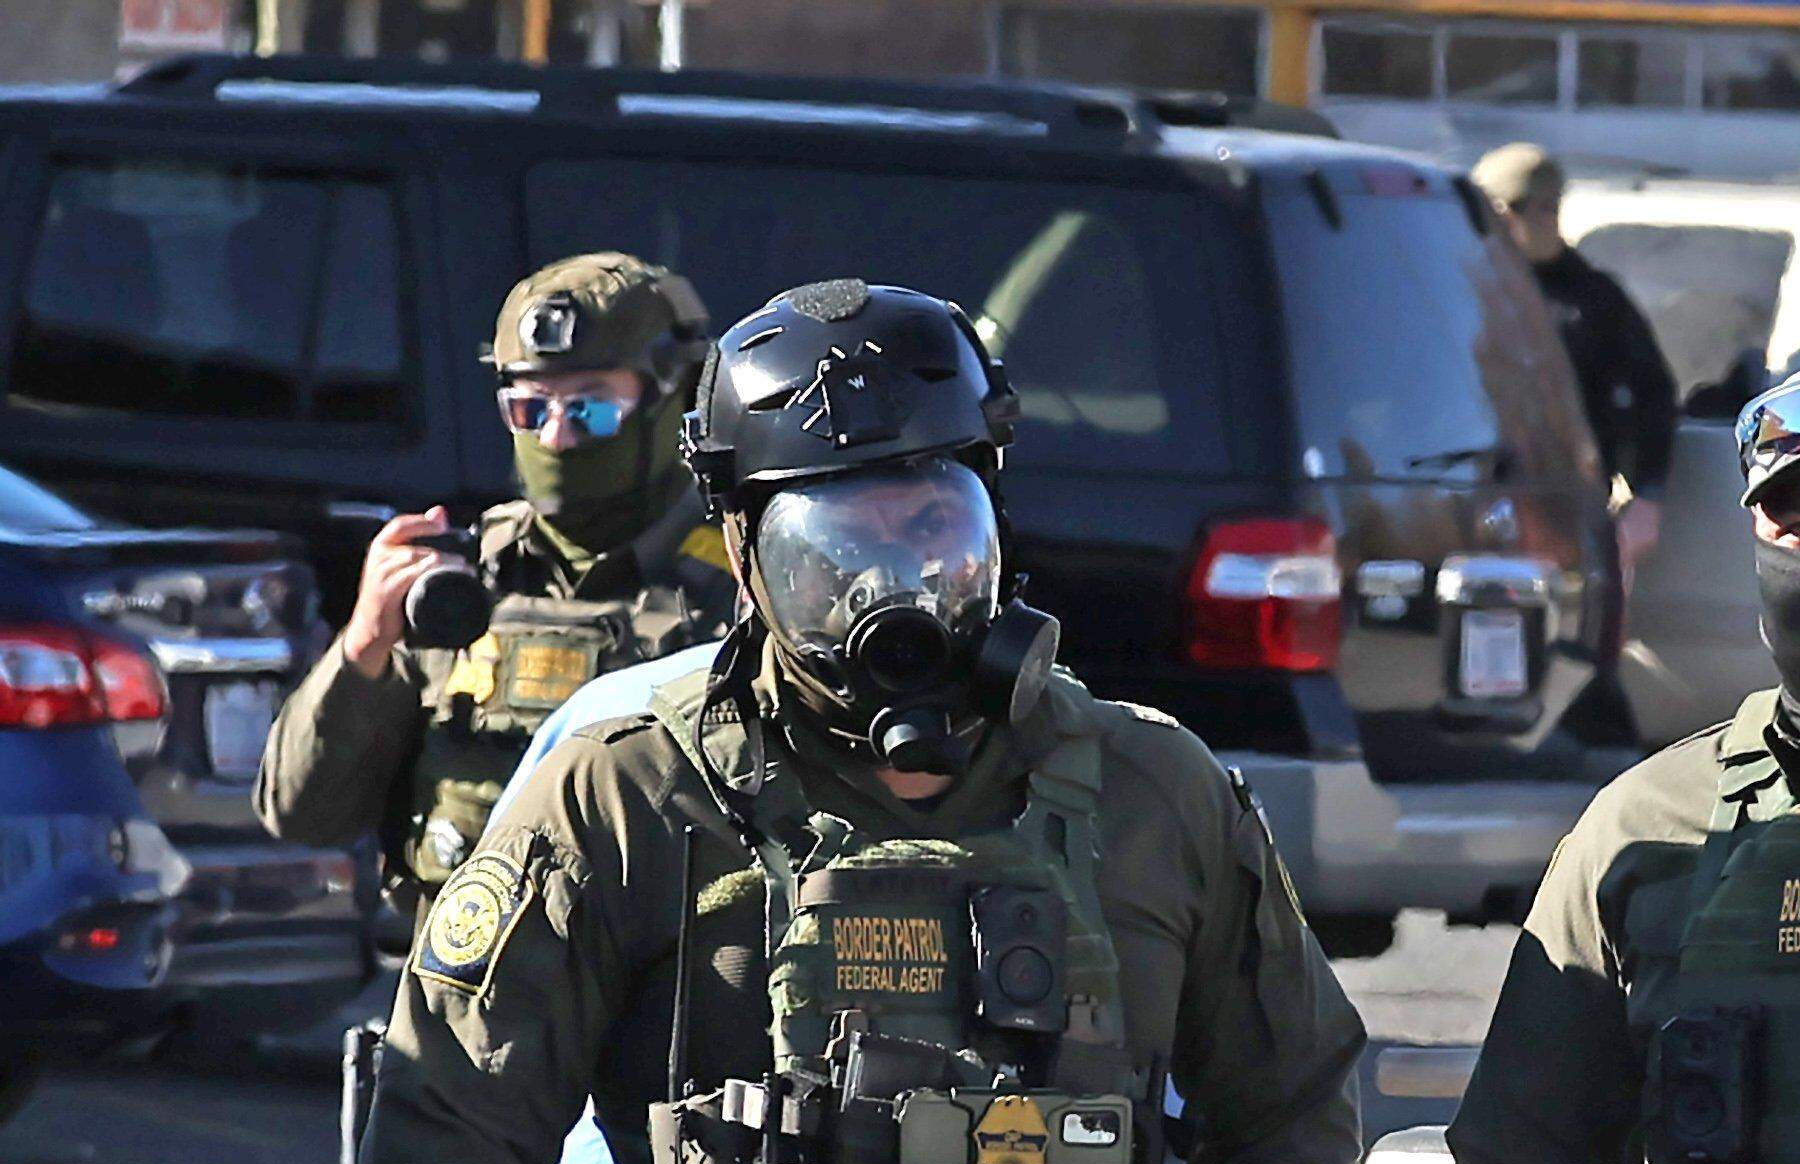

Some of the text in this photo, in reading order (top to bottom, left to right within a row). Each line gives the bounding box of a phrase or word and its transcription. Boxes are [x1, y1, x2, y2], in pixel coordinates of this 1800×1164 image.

[833, 917, 948, 963] BORDER PATROL
[837, 965, 945, 993] FEDERAL AGENT
